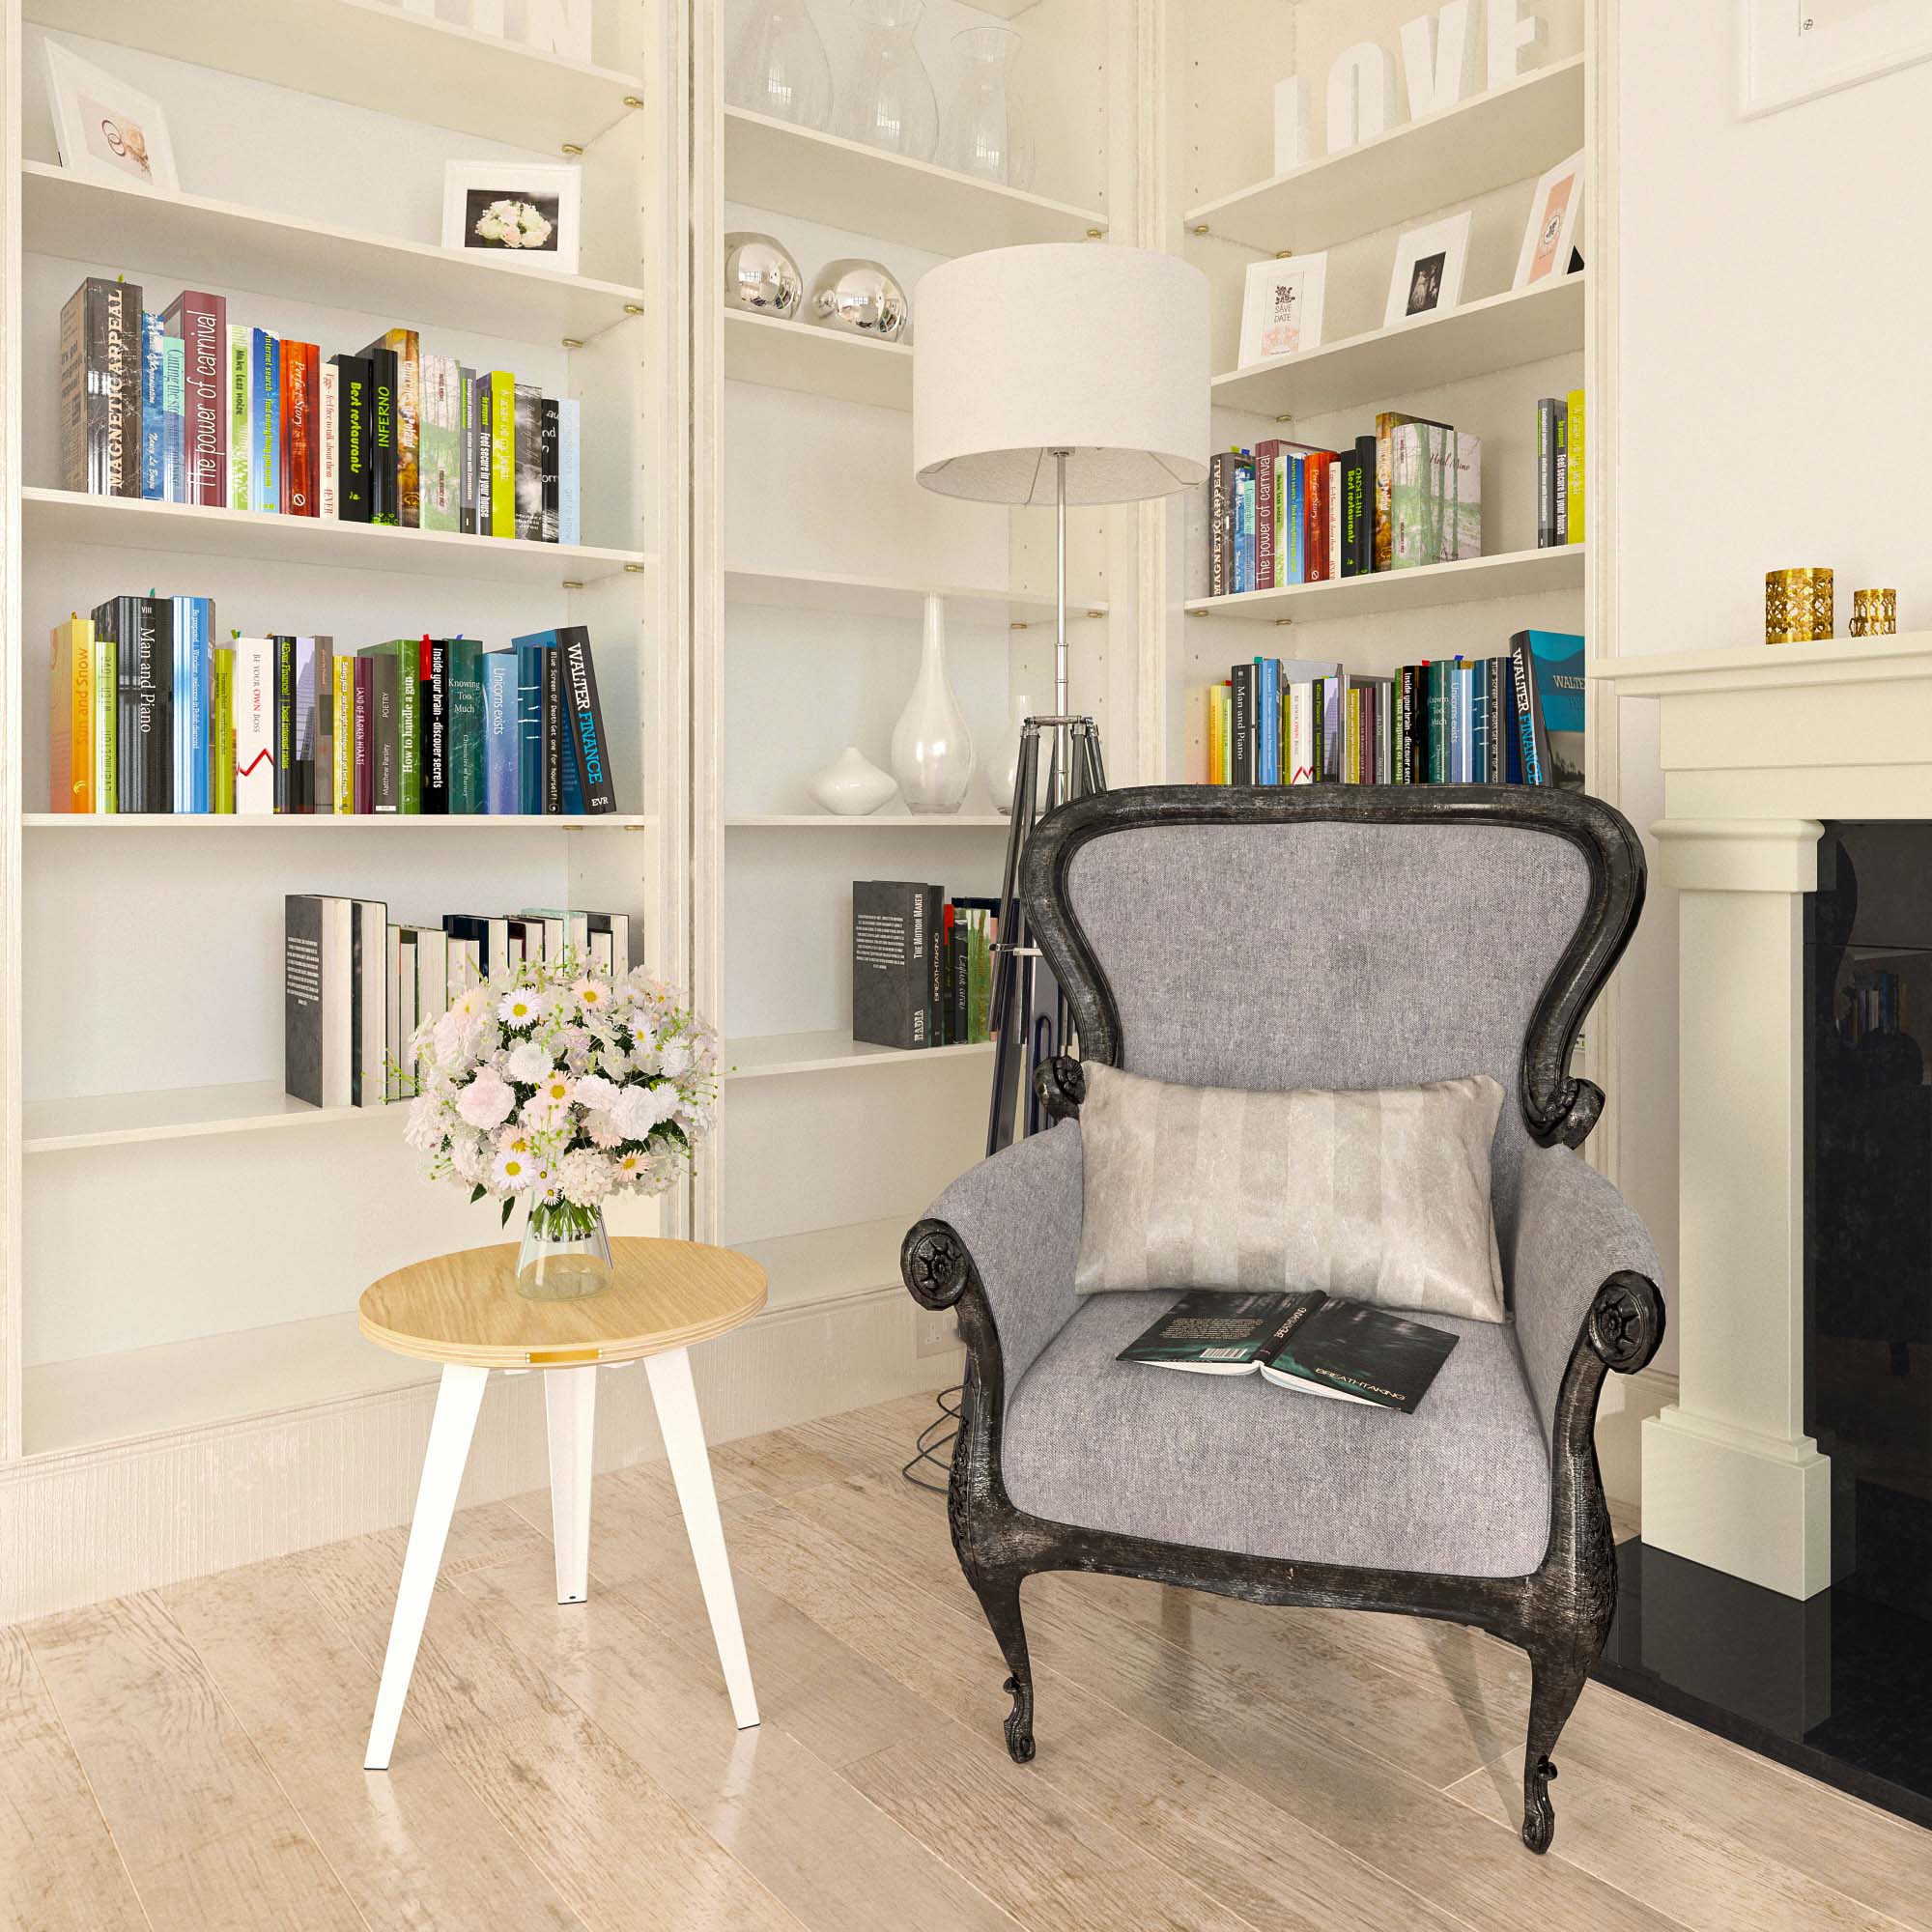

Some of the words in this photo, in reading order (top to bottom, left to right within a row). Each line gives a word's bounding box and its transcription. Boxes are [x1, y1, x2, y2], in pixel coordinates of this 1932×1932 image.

[186, 310, 217, 375] carnival
[163, 350, 185, 384] Cutting
[236, 350, 245, 371] Make
[186, 377, 217, 399] of
[293, 361, 305, 396] Perfect
[166, 385, 185, 399] the
[236, 392, 245, 415] noise
[351, 382, 362, 406] Best
[293, 399, 305, 426] Story
[378, 386, 390, 448] INFERNO
[107, 377, 123, 489] MAGNETIC
[197, 404, 225, 455] power
[351, 410, 362, 473] restaurants
[403, 418, 416, 448] Poland
[481, 433, 490, 447] Feel
[481, 448, 490, 470] secure
[1557, 454, 1566, 470] Feel
[186, 459, 217, 487] The
[1256, 455, 1271, 500] carnival
[1557, 471, 1566, 493] secure
[479, 479, 488, 495] your
[481, 497, 490, 518] house
[1256, 505, 1270, 517] of
[1557, 498, 1566, 515] your
[1557, 515, 1566, 535] house
[1260, 523, 1275, 557] power
[1257, 560, 1270, 582] The
[141, 627, 156, 659] Man
[76, 647, 88, 685] Snow
[99, 656, 112, 680] love
[433, 648, 443, 673] Inside
[141, 664, 156, 689] and
[403, 676, 414, 695] gun
[430, 674, 440, 694] your
[448, 678, 480, 690] Knowing
[493, 668, 506, 708] Unicorns
[1404, 672, 1412, 695] Inside
[1512, 647, 1529, 713] WALTER
[1552, 675, 1585, 690] WALTE
[76, 691, 88, 716] and
[99, 687, 112, 712] with
[433, 694, 443, 715] brain
[454, 704, 475, 713] Much
[550, 694, 557, 702] Of
[1236, 686, 1245, 707] Man
[1451, 682, 1460, 720] Unicorns
[141, 693, 156, 733] Piano
[356, 705, 364, 715] OF
[403, 704, 414, 738] handle
[493, 709, 506, 735] exists
[567, 642, 590, 711] WALTER
[579, 712, 604, 784] FINANCE
[1236, 710, 1245, 729] and
[1404, 712, 1412, 730] brain
[76, 718, 88, 745] Sun
[433, 722, 443, 757] discover
[403, 739, 414, 749] to
[1236, 732, 1245, 760] Piano
[1404, 736, 1412, 767] discover
[1520, 713, 1543, 784] FINANCE
[403, 750, 414, 774] How
[433, 758, 443, 788] secrets
[591, 797, 609, 807] EVR
[913, 894, 923, 918] MAKER
[913, 918, 923, 945] MOTION
[913, 945, 923, 958] THE
[1315, 1367, 1406, 1401] BREATHTAKING
